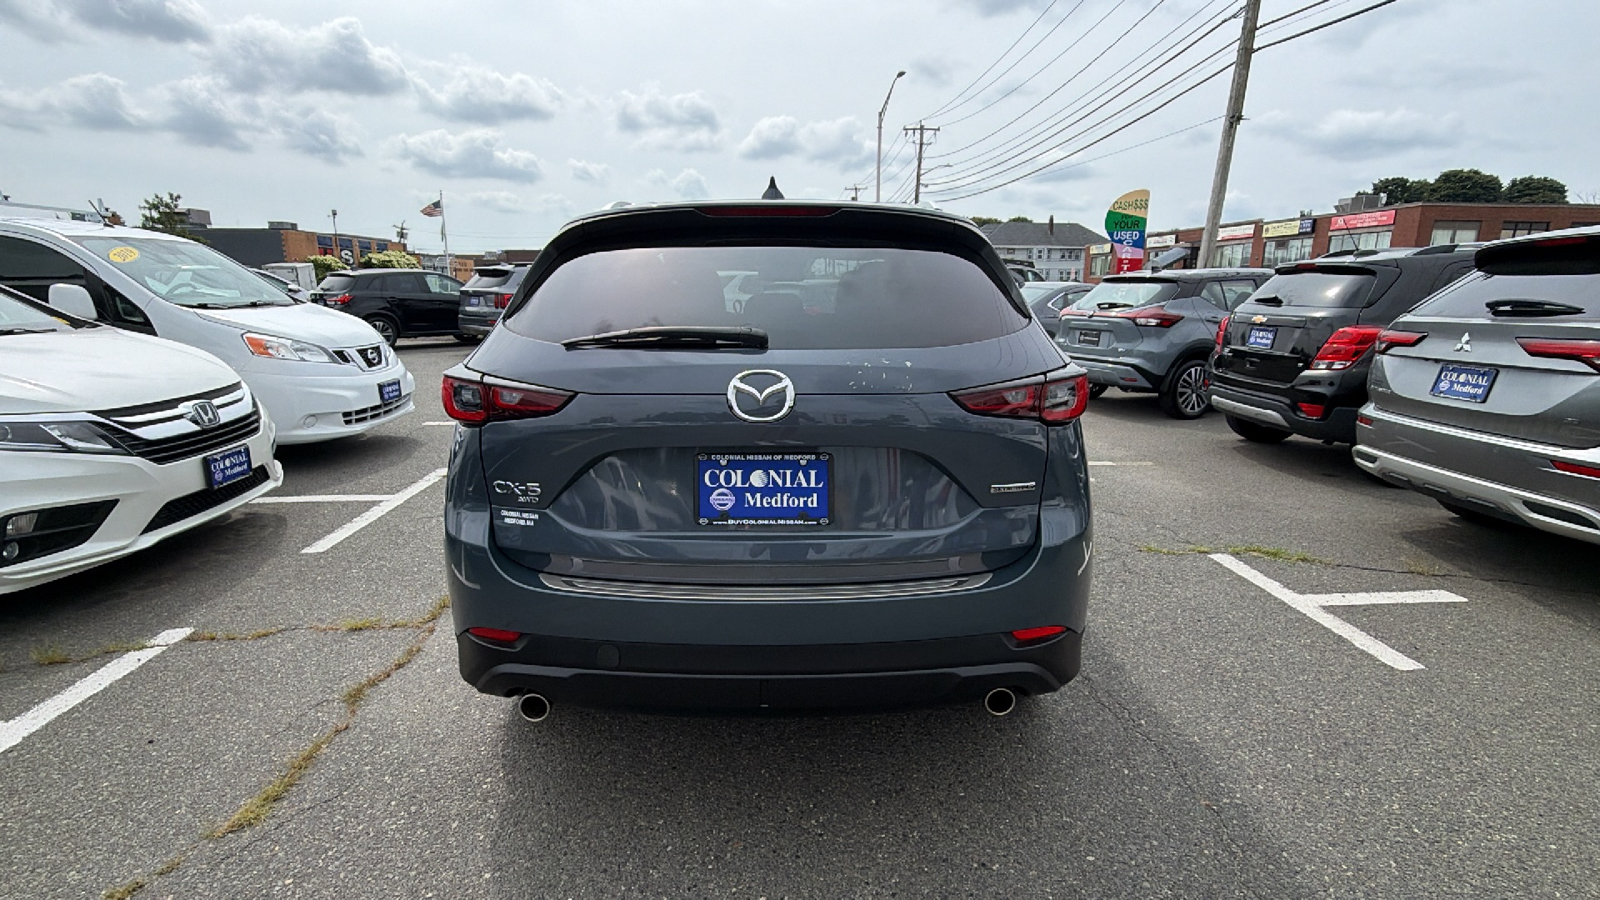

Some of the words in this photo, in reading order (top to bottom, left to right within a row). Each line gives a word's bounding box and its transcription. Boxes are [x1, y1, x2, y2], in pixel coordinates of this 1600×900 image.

[1114, 220, 1140, 229] YOUR
[1113, 230, 1140, 240] USED
[340, 249, 354, 264] S
[1441, 371, 1489, 385] COLONIAL
[1451, 383, 1484, 394] Medford
[211, 453, 248, 472] COLONIAL
[224, 463, 248, 477] Medford
[704, 469, 824, 488] COLONIAL
[493, 480, 541, 496] CX-5
[744, 492, 818, 508] Medford
